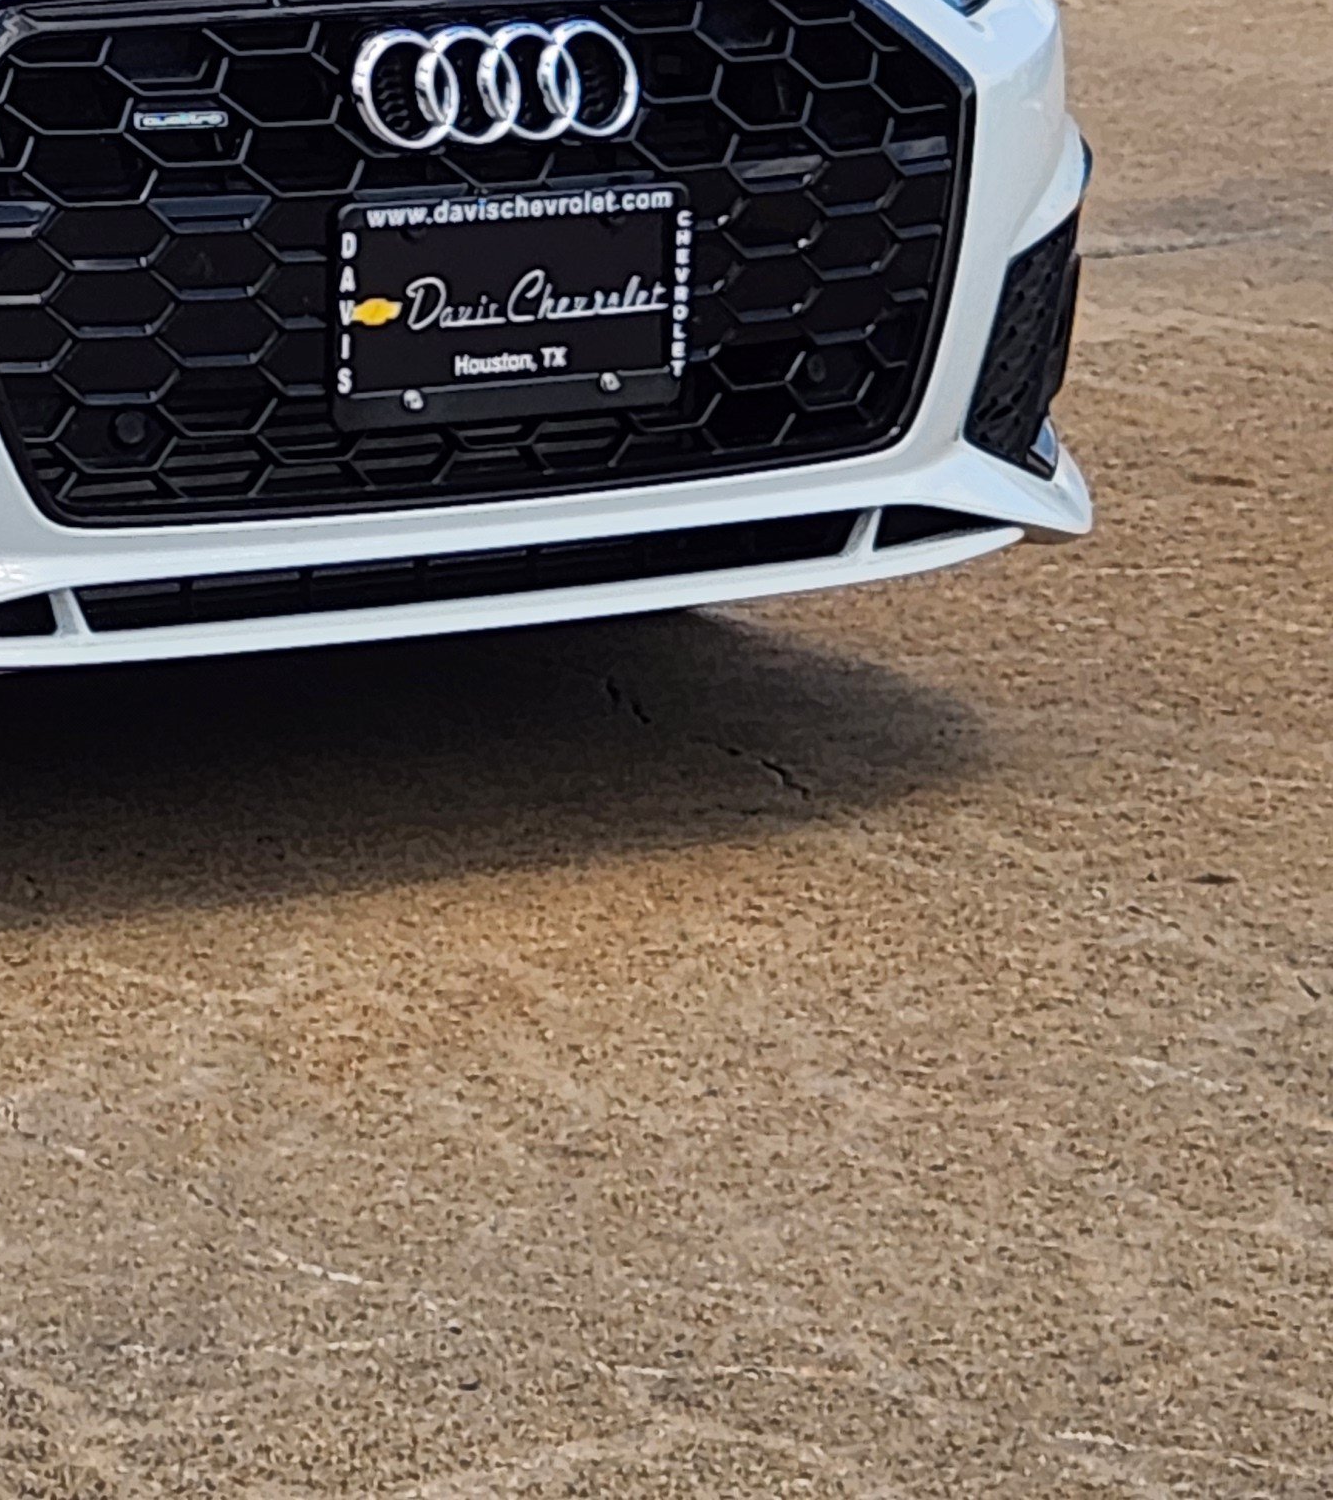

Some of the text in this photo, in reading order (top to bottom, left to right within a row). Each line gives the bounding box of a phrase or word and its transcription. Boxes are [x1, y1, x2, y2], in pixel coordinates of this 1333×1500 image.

[366, 191, 674, 228] www.davischevrolet.com
[337, 231, 358, 395] DAVIS
[405, 269, 669, 331] Davis Chevrolet
[670, 210, 693, 377] CHEVROLET
[454, 346, 568, 376] Houston, TX
